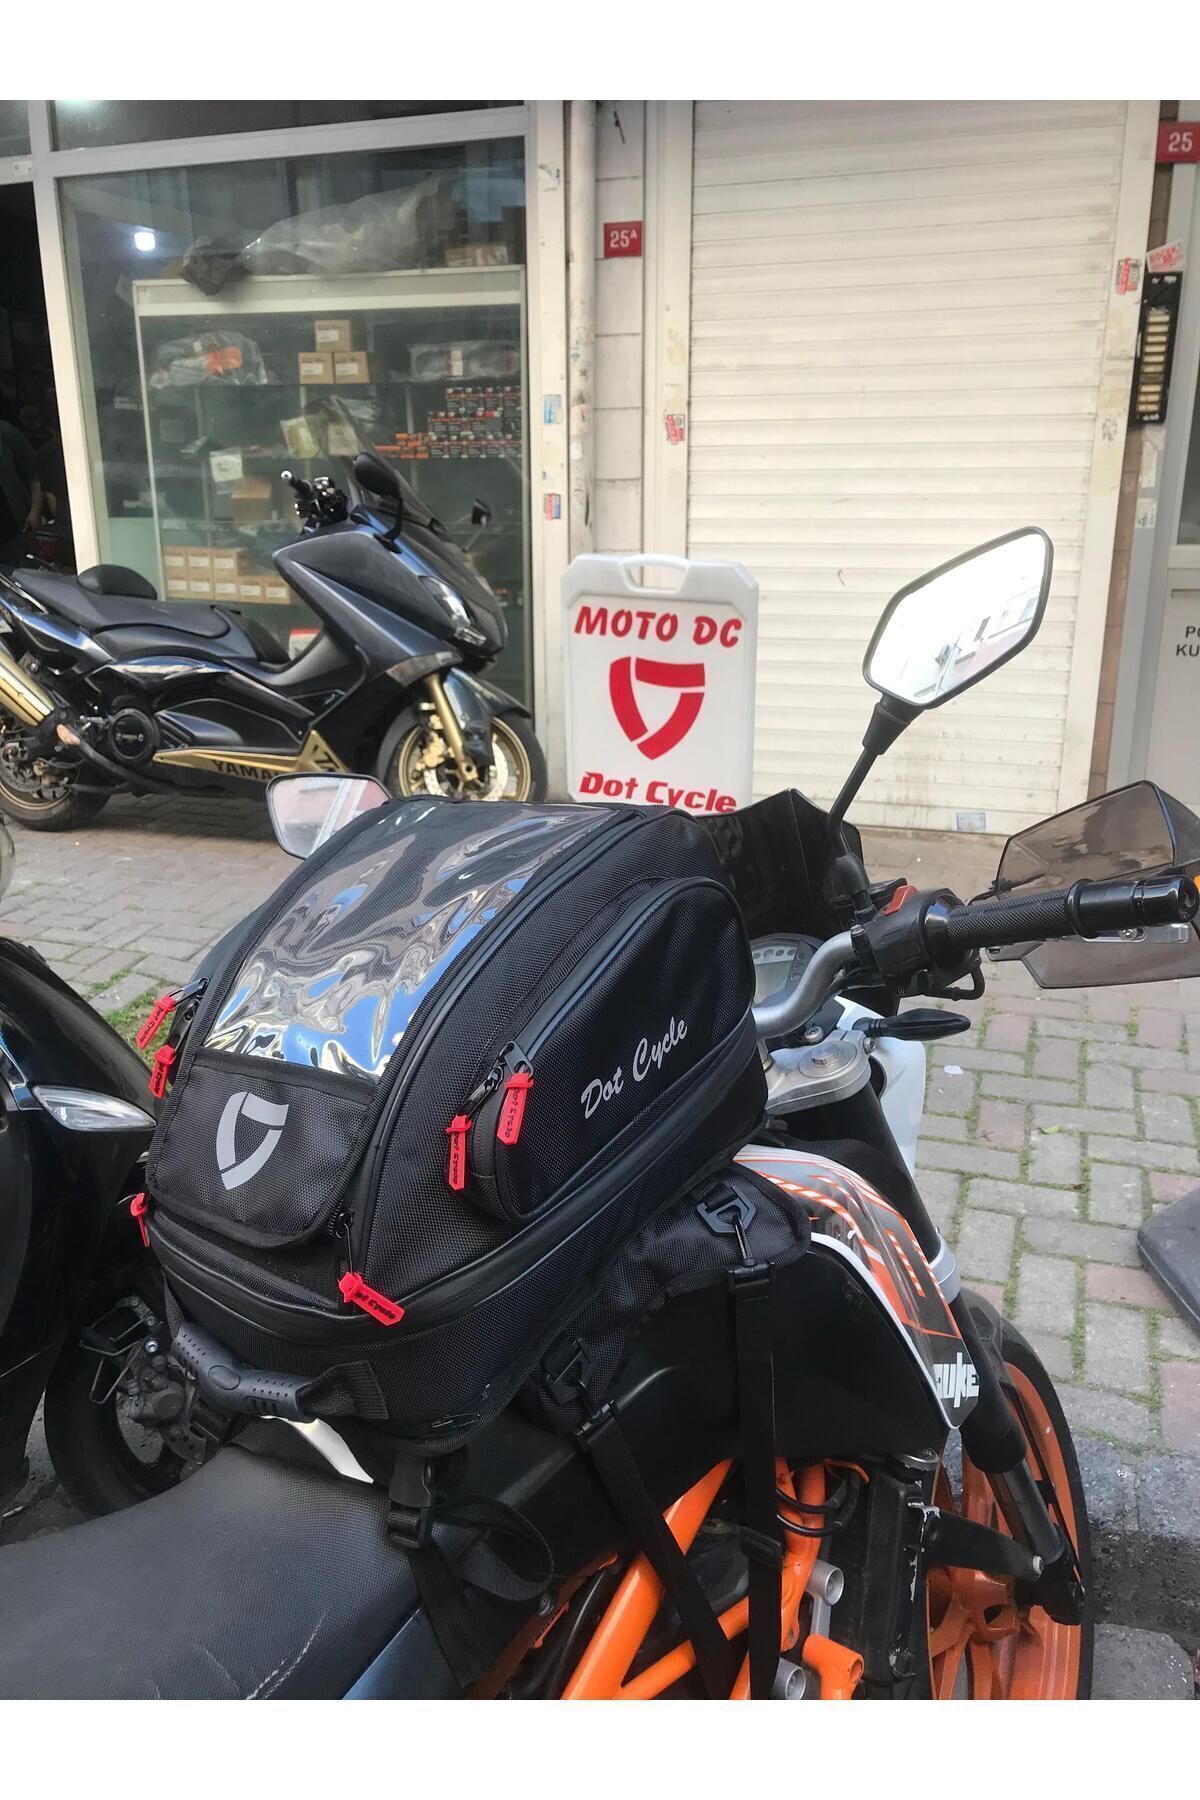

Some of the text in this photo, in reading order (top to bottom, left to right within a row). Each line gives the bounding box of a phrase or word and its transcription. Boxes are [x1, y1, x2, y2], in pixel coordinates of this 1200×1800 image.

[1168, 132, 1193, 153] 25
[610, 229, 638, 248] 25A
[574, 606, 742, 648] MOTO DC
[1185, 626, 1200, 639] P
[211, 760, 279, 780] YAMA
[579, 771, 737, 813] Dot Cycle
[580, 1016, 688, 1119] Dot Cycle
